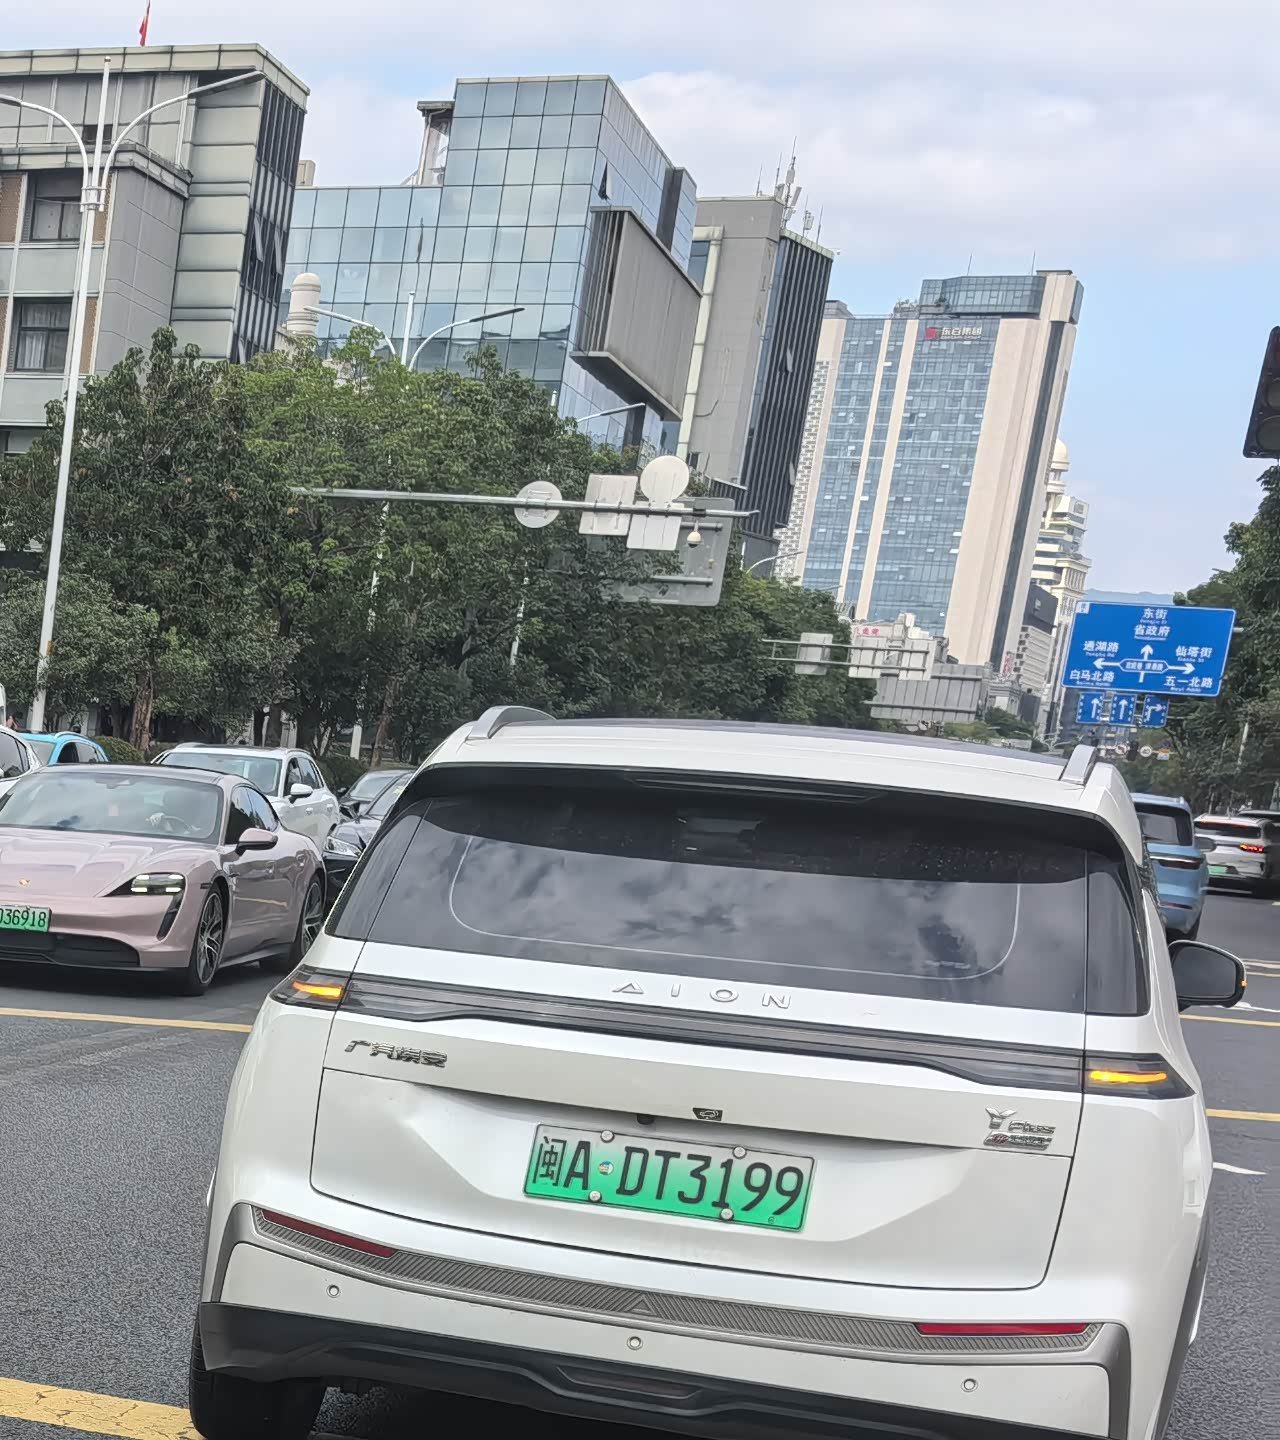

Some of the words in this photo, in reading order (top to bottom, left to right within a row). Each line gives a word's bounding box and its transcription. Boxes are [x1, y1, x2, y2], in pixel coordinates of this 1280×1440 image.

[942, 327, 982, 336] 东百集团
[1143, 608, 1168, 620] 东街
[1134, 624, 1171, 638] 省政府
[1082, 640, 1120, 654] 通湖路
[1175, 645, 1213, 659] 仙塔街
[1069, 669, 1115, 683] 白马北路
[1163, 675, 1213, 689] 五一北路
[612, 982, 791, 1010] AION
[344, 1040, 448, 1068] 广汽埃安
[532, 1136, 591, 1191] 闽A
[615, 1145, 805, 1216] DT3199
